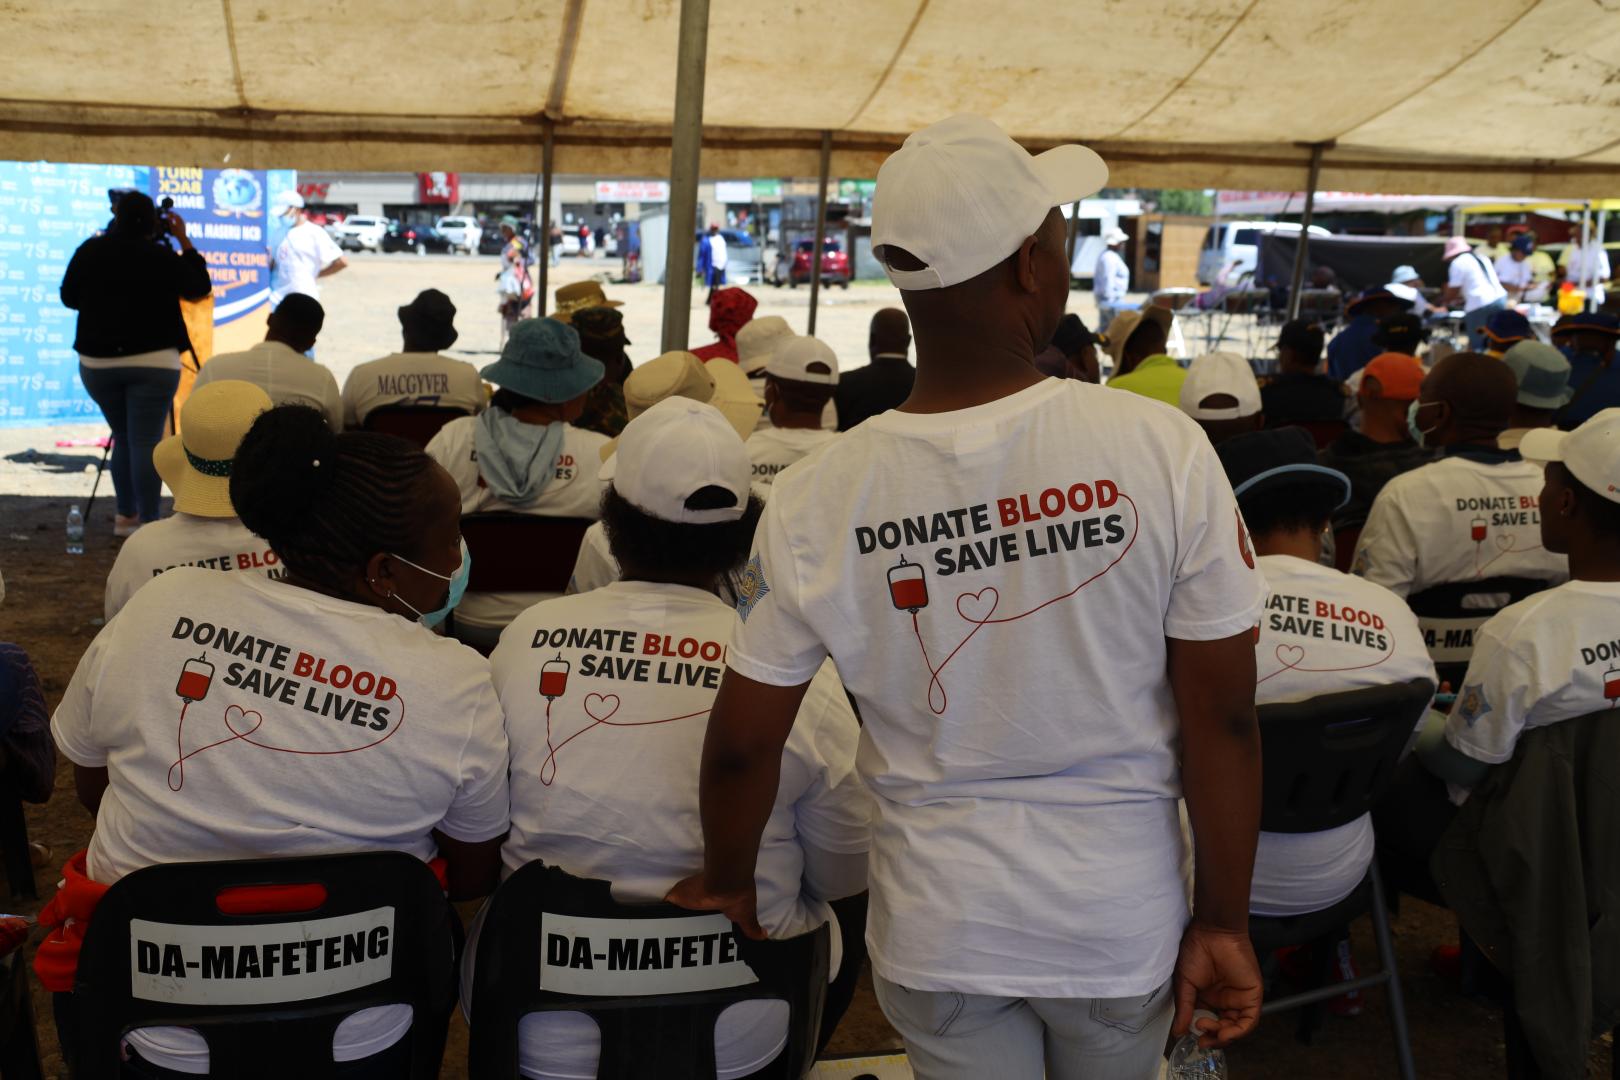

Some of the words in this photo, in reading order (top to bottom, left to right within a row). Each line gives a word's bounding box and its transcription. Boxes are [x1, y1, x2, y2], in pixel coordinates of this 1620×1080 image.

[377, 374, 449, 395] MACGYVER
[855, 503, 991, 555] DONATE
[996, 479, 1118, 527] BLOOD
[1456, 497, 1517, 511] DONATE
[1492, 511, 1528, 526] SAVE
[934, 533, 1020, 576] SAVE
[1025, 514, 1125, 558] LIVES
[1264, 594, 1310, 615] ATE
[1315, 600, 1384, 630] BLOOD
[531, 628, 637, 653] DONATE
[642, 633, 728, 664] BLOO
[1269, 614, 1324, 638] SAVE
[1331, 623, 1388, 651] LIVES
[171, 616, 291, 671] DONATE
[292, 652, 397, 701] BLOOD
[578, 654, 651, 682] SAVE
[222, 662, 301, 706] SAVE
[303, 686, 391, 731] LIVES
[137, 925, 389, 979] DA-MAFETENG
[547, 931, 744, 971] DA-MAFETE
